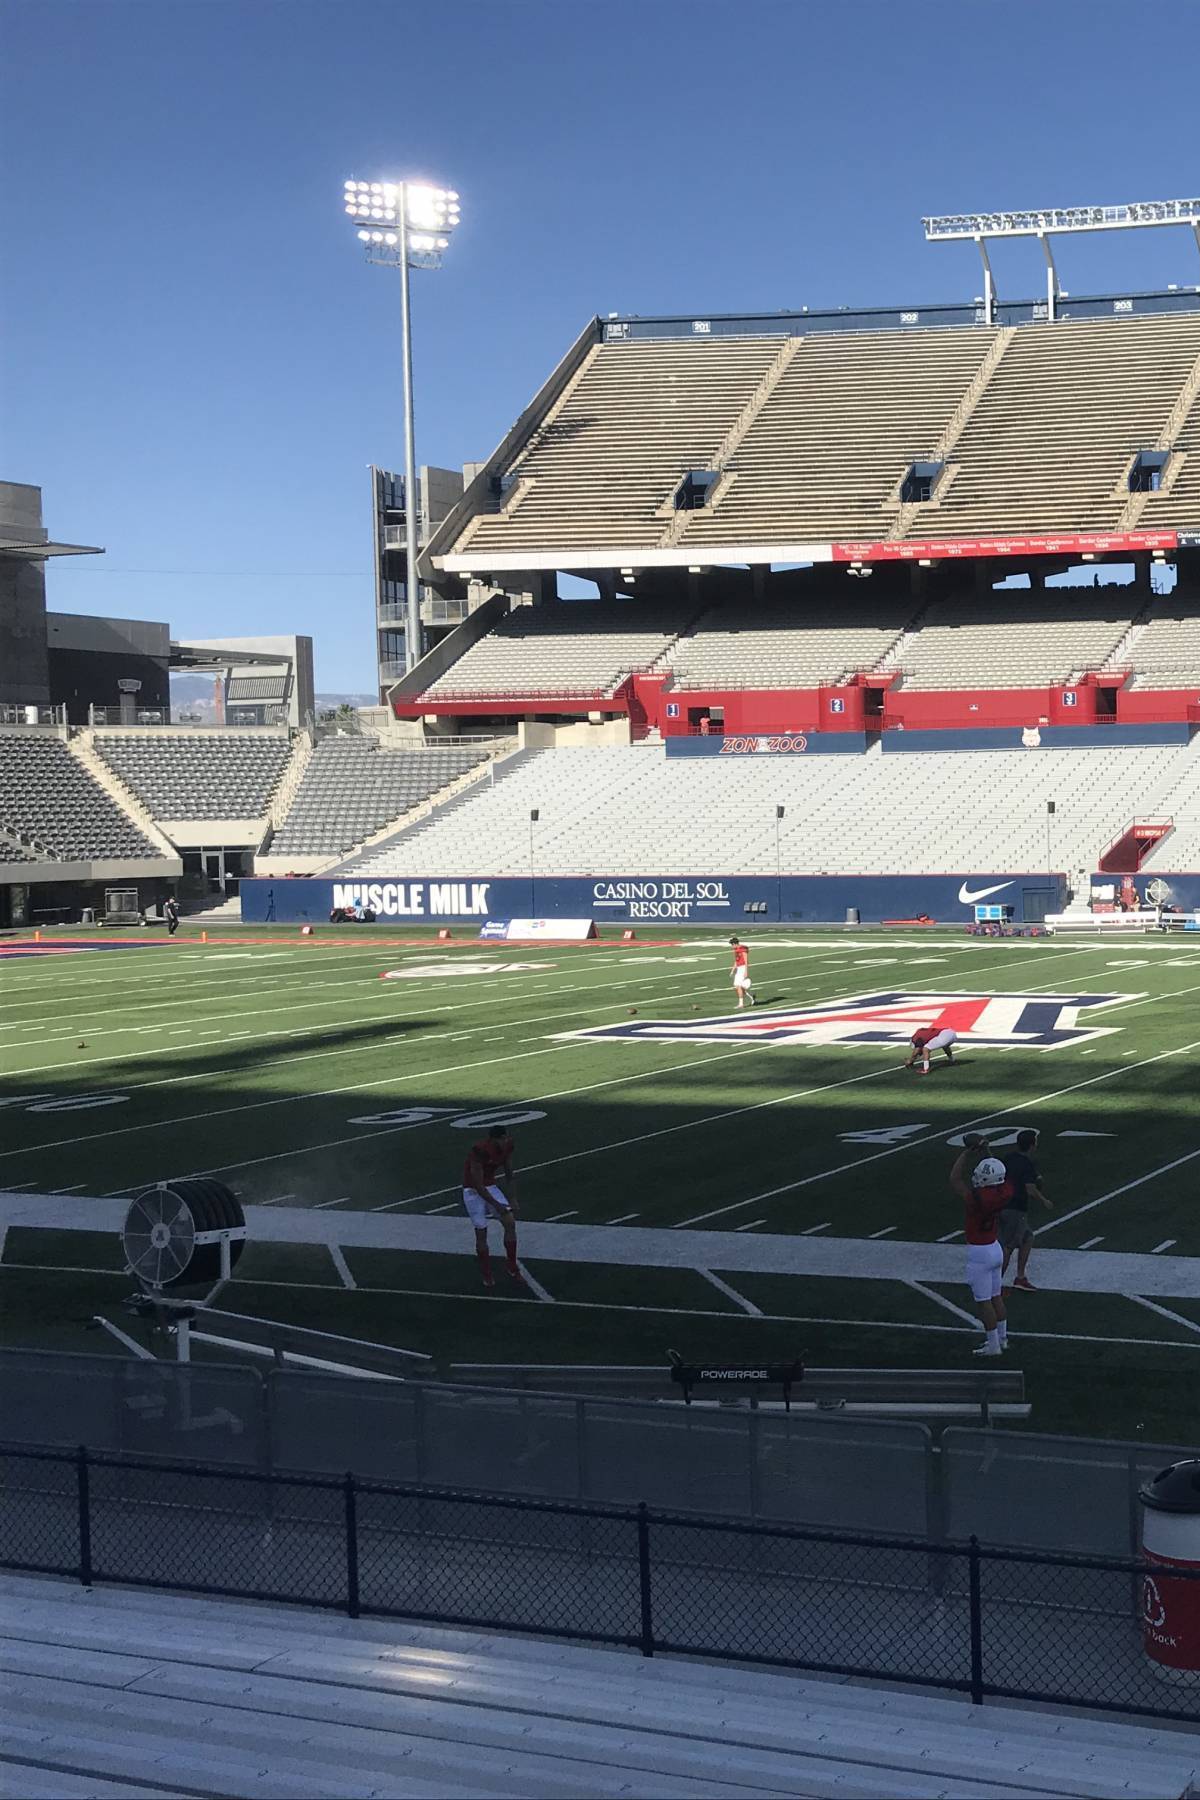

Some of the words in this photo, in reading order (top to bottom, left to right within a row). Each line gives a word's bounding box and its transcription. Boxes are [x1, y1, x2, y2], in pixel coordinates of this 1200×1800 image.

[694, 323, 710, 332] 201
[593, 882, 658, 899] CASINO
[662, 882, 695, 899] DEL
[696, 882, 729, 899] SOL
[333, 884, 424, 915] MUSCLE
[429, 884, 490, 915] MILK
[629, 901, 693, 918] RESORT
[701, 1370, 768, 1379] POWERADE
